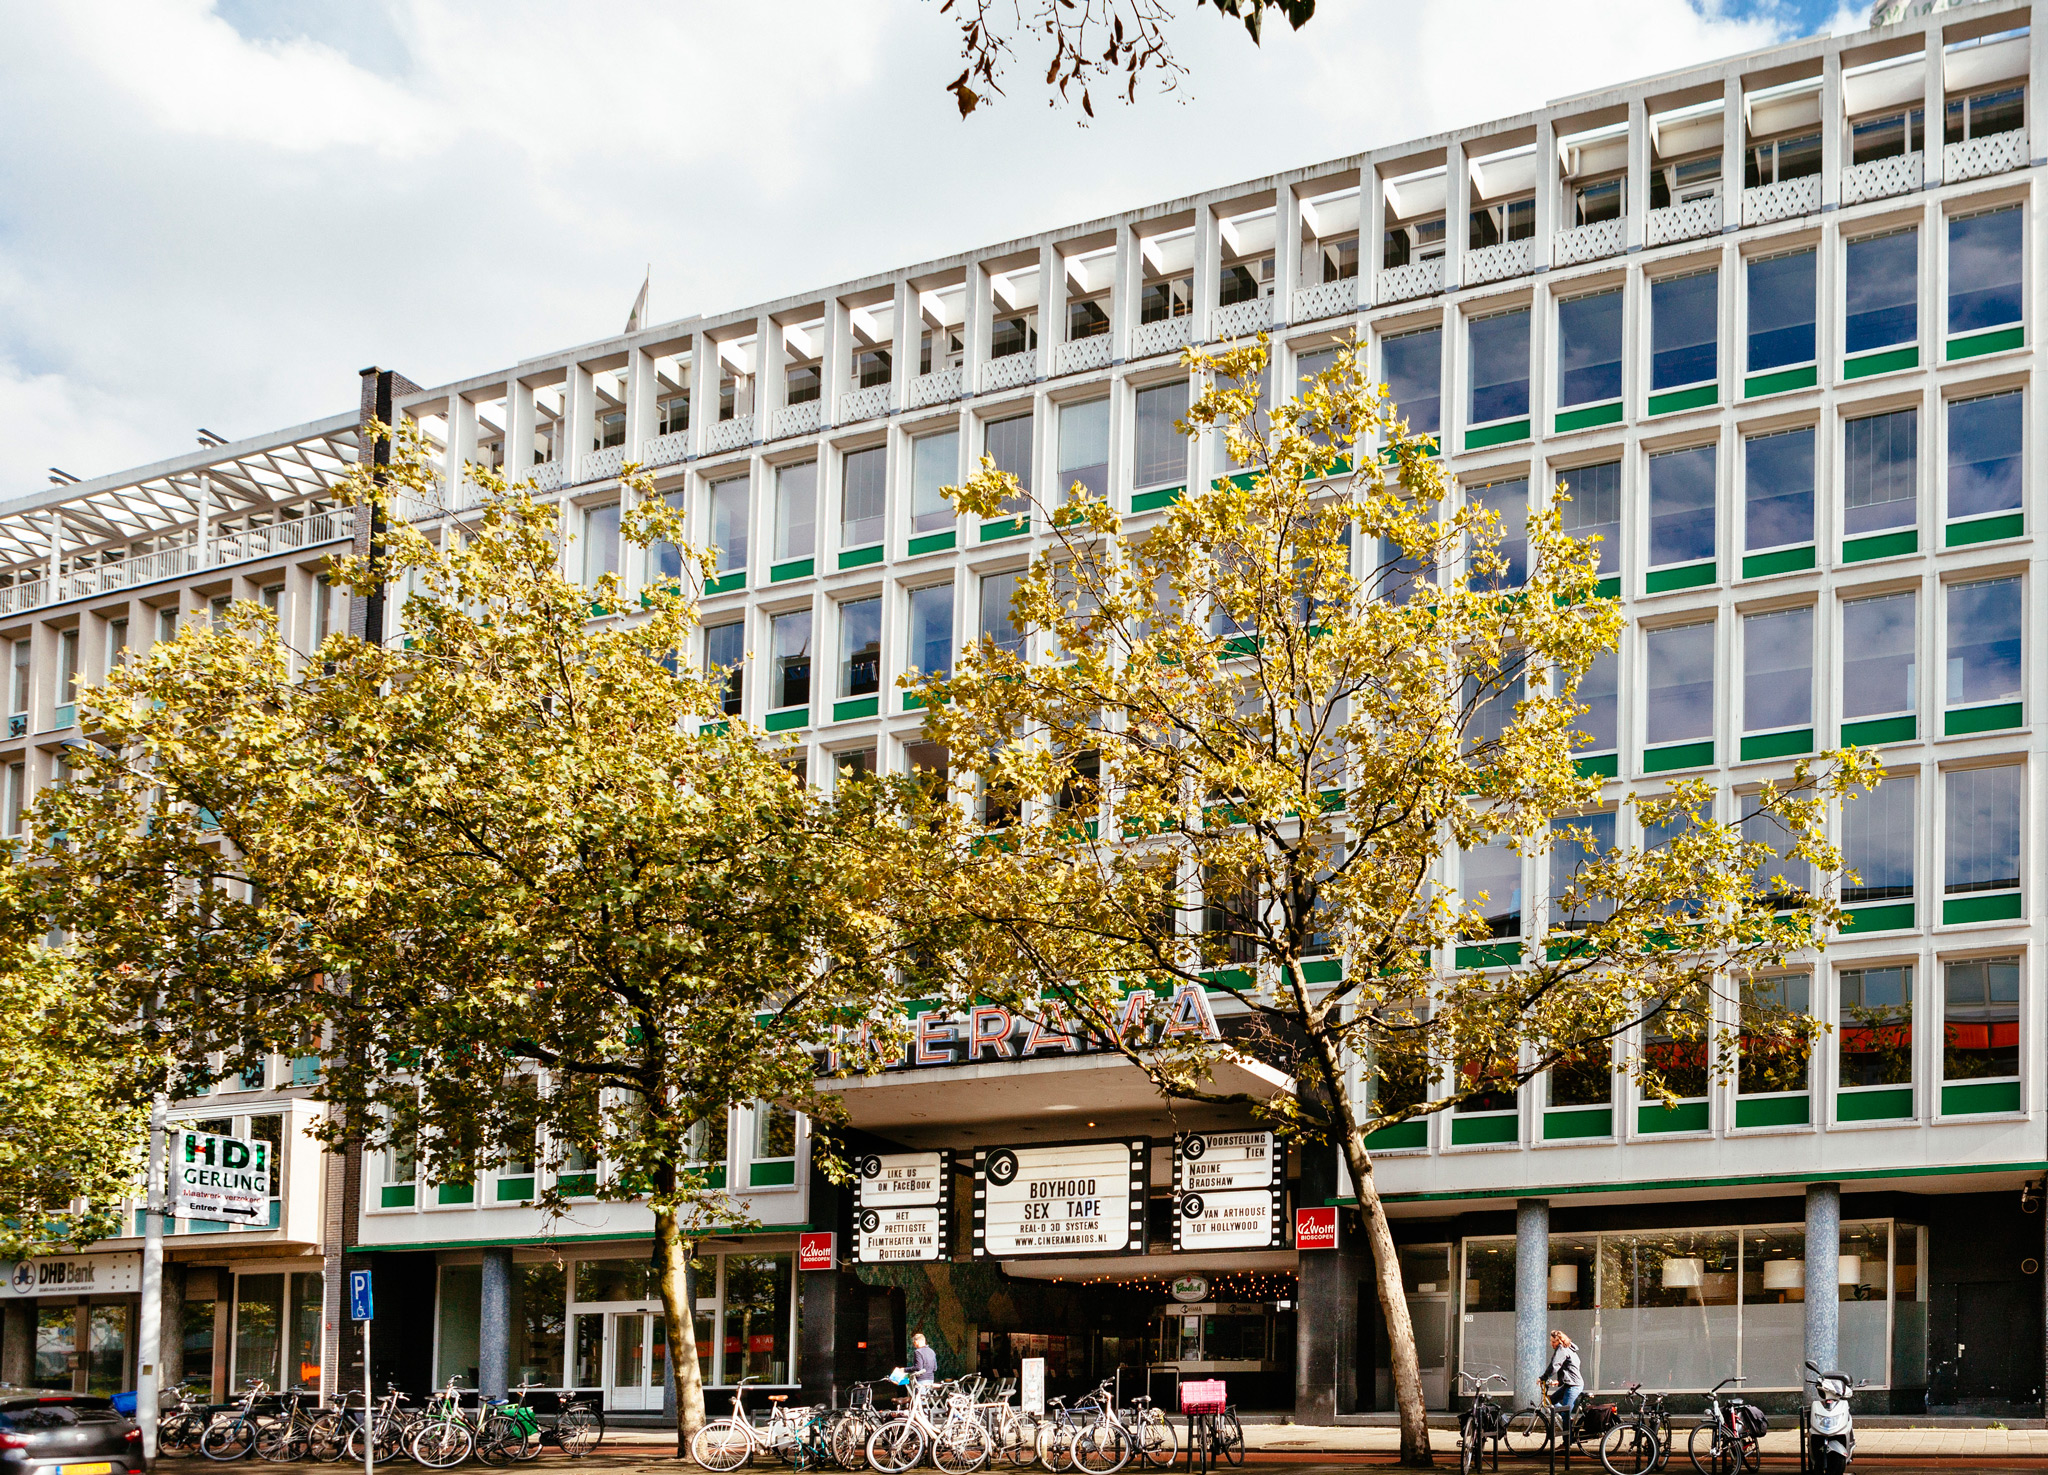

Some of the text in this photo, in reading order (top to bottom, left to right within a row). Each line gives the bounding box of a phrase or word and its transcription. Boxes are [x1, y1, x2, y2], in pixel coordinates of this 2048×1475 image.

[185, 1134, 265, 1173] HDI
[1245, 1147, 1265, 1159] TIEN
[887, 1168, 917, 1179] LIKE US
[1189, 1164, 1221, 1176] NADINE
[184, 1168, 265, 1192] GERLING
[1188, 1177, 1234, 1189] BRADSHAW
[878, 1182, 888, 1191] ON
[1030, 1179, 1096, 1199] BOYHOOD
[190, 1202, 218, 1212] Entree
[1024, 1200, 1101, 1220] SEX TAPE
[1204, 1206, 1266, 1219] VAN ARTHOUSE
[895, 1211, 910, 1221] HET
[884, 1223, 926, 1233] PRETTIGSTE
[1020, 1221, 1099, 1233] REAL-D 3D SYSTEMS
[1192, 1221, 1258, 1233] TOT HOLLYWOOD
[1311, 1224, 1334, 1234] Wolff
[918, 1236, 932, 1245] VAN
[1015, 1234, 1107, 1246] WWW.CINERAMABIOS.NL
[811, 1247, 831, 1257] Wolff
[39, 1261, 95, 1284] DHB Bank
[354, 1275, 365, 1300] P
[353, 1326, 365, 1336] 14
